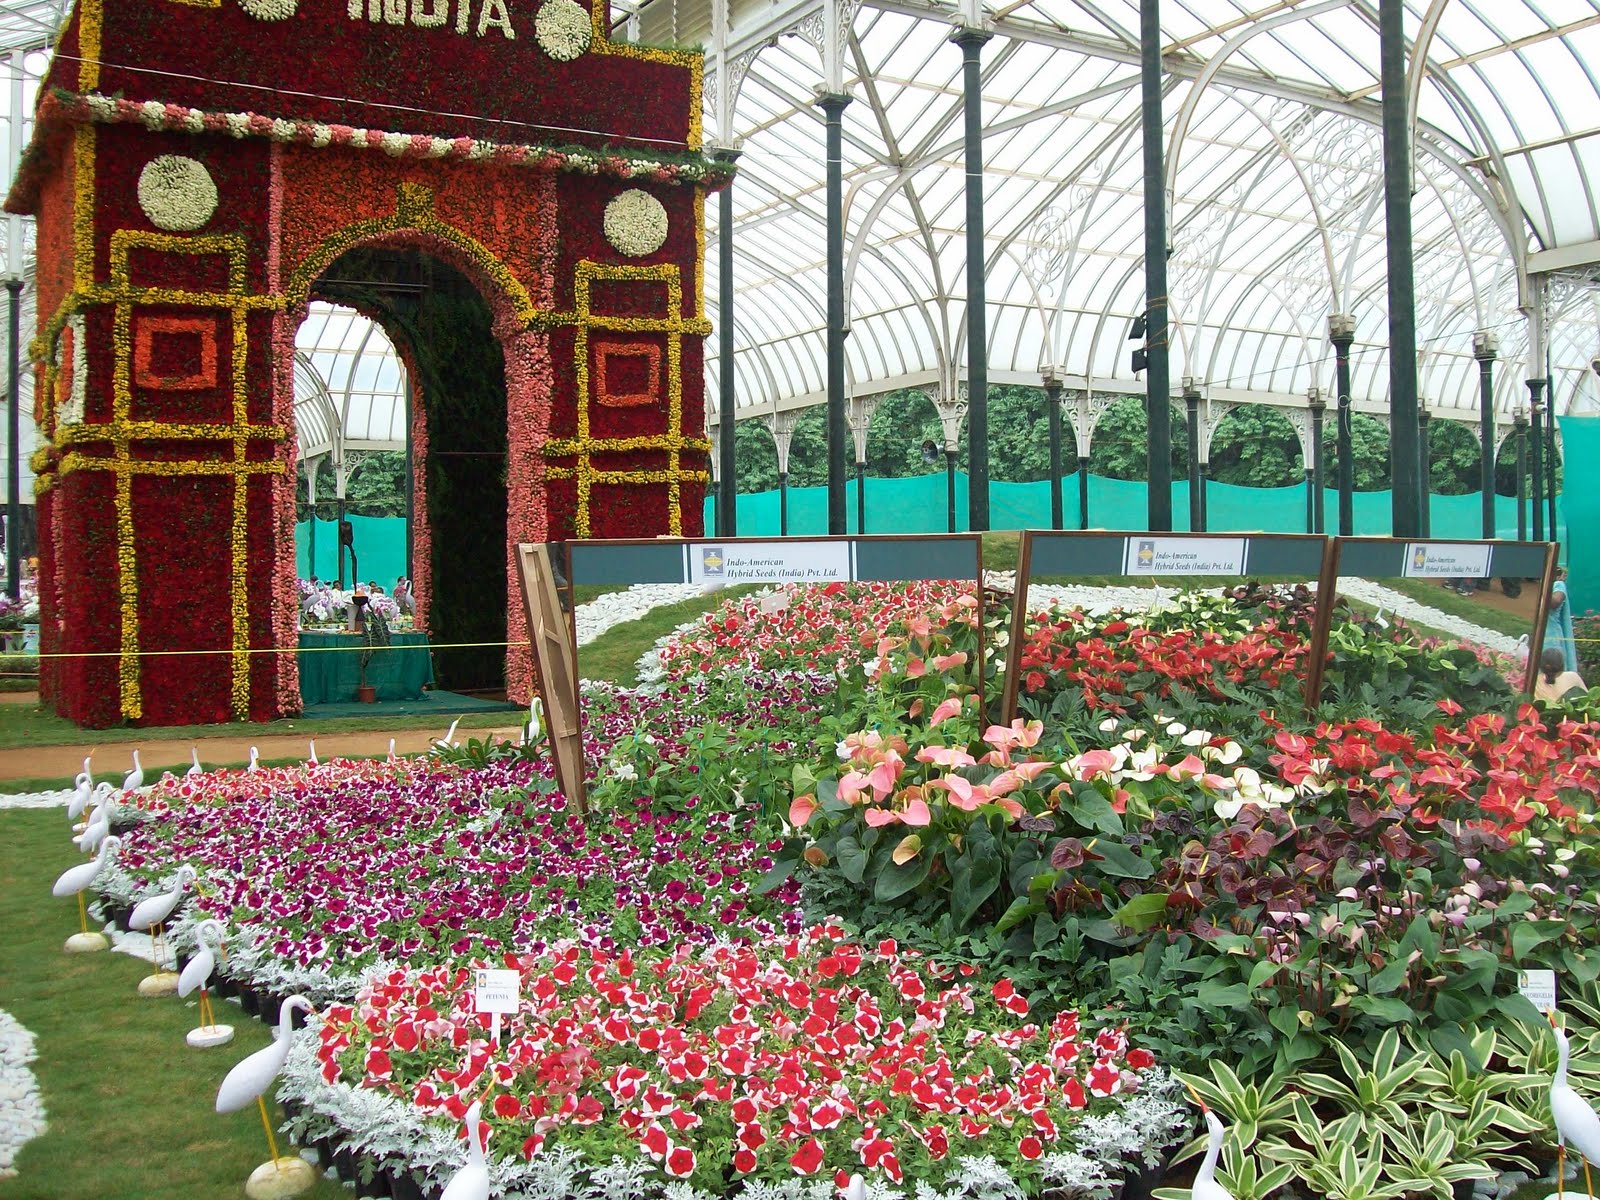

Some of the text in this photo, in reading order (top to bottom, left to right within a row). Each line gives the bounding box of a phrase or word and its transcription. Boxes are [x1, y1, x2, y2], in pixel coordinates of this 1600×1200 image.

[1155, 551, 1198, 560] Indo-American
[726, 557, 784, 566] Indo-American
[1154, 562, 1175, 571] Hybrid
[1175, 563, 1191, 571] Seeds
[1192, 563, 1211, 571] (India)
[727, 568, 839, 579] Hybrid Seeds (India) Pvt. Ltd.
